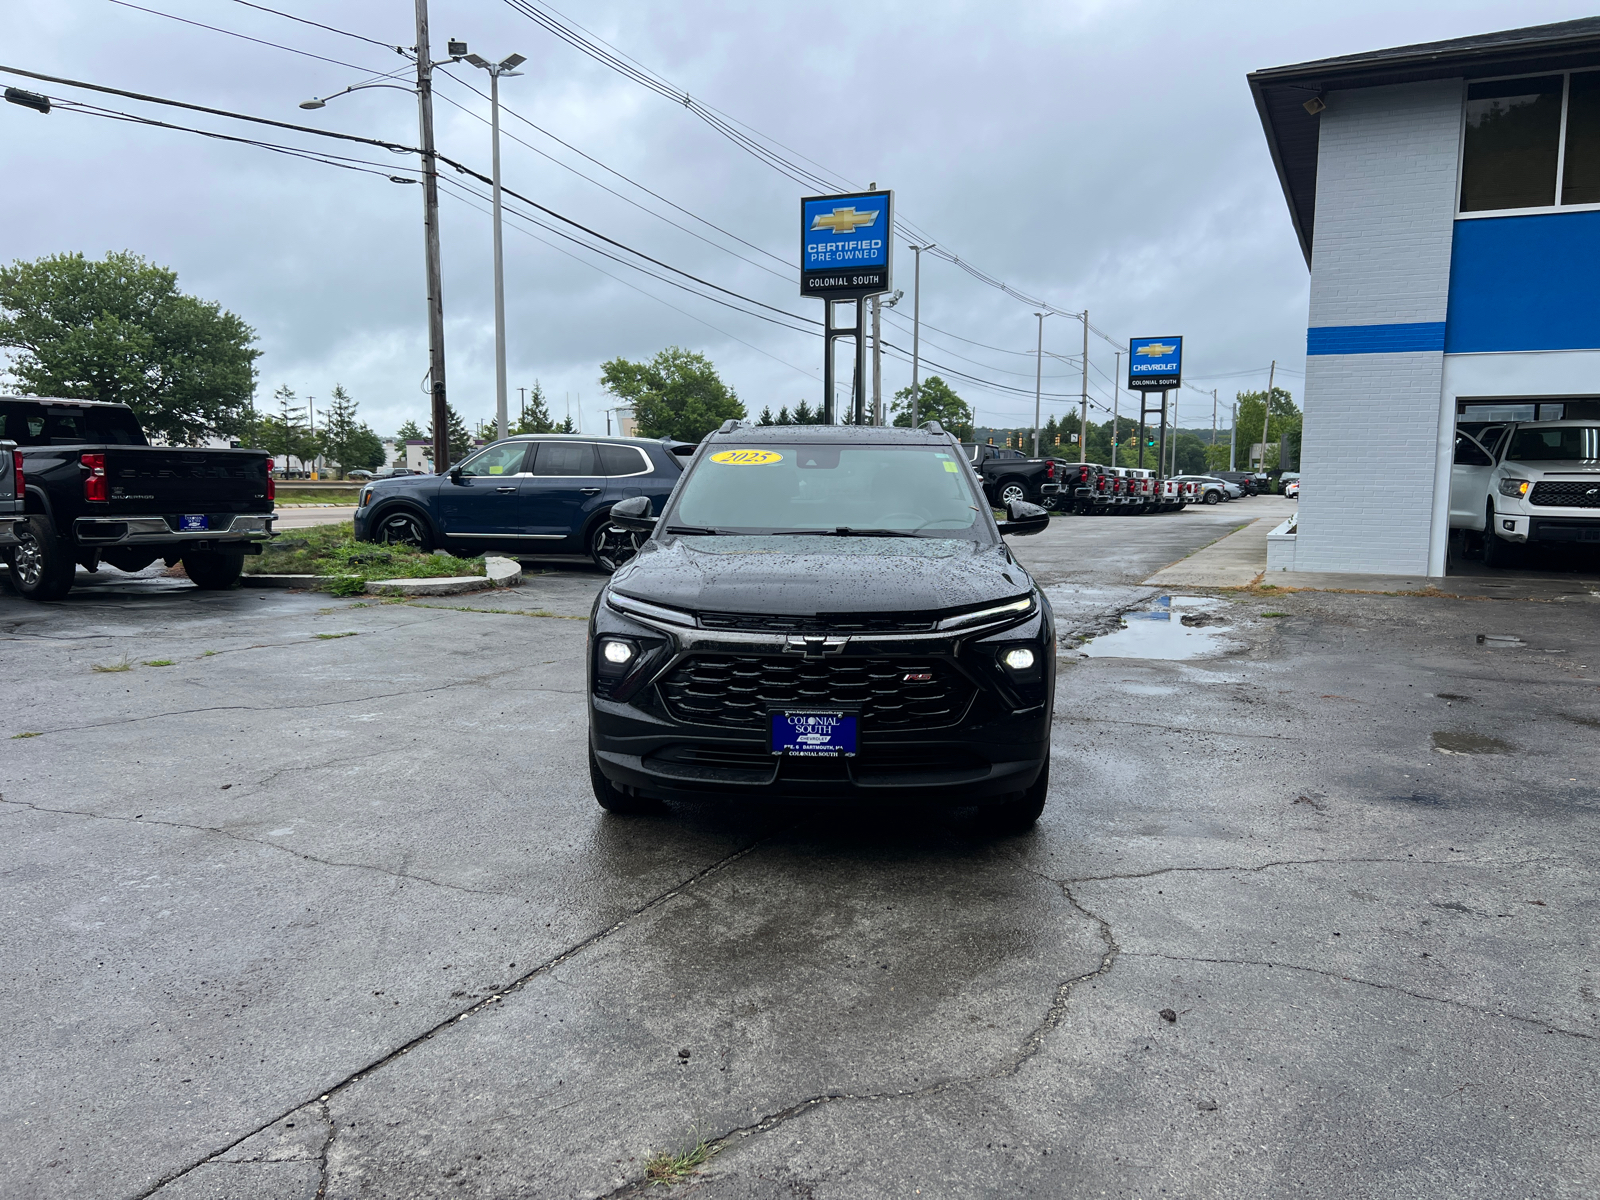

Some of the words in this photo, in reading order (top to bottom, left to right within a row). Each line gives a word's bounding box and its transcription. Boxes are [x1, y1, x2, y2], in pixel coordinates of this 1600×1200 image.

[807, 239, 882, 253] CERTIFIED
[811, 249, 878, 262] PRE-OWNED
[809, 277, 848, 287] COLONIAL
[853, 275, 879, 285] SOUTH
[1133, 363, 1177, 371] CHEVROLET
[720, 452, 772, 462] 2025
[903, 673, 932, 681] RS
[788, 716, 841, 726] COLONIAL
[795, 725, 832, 734] SOUTH
